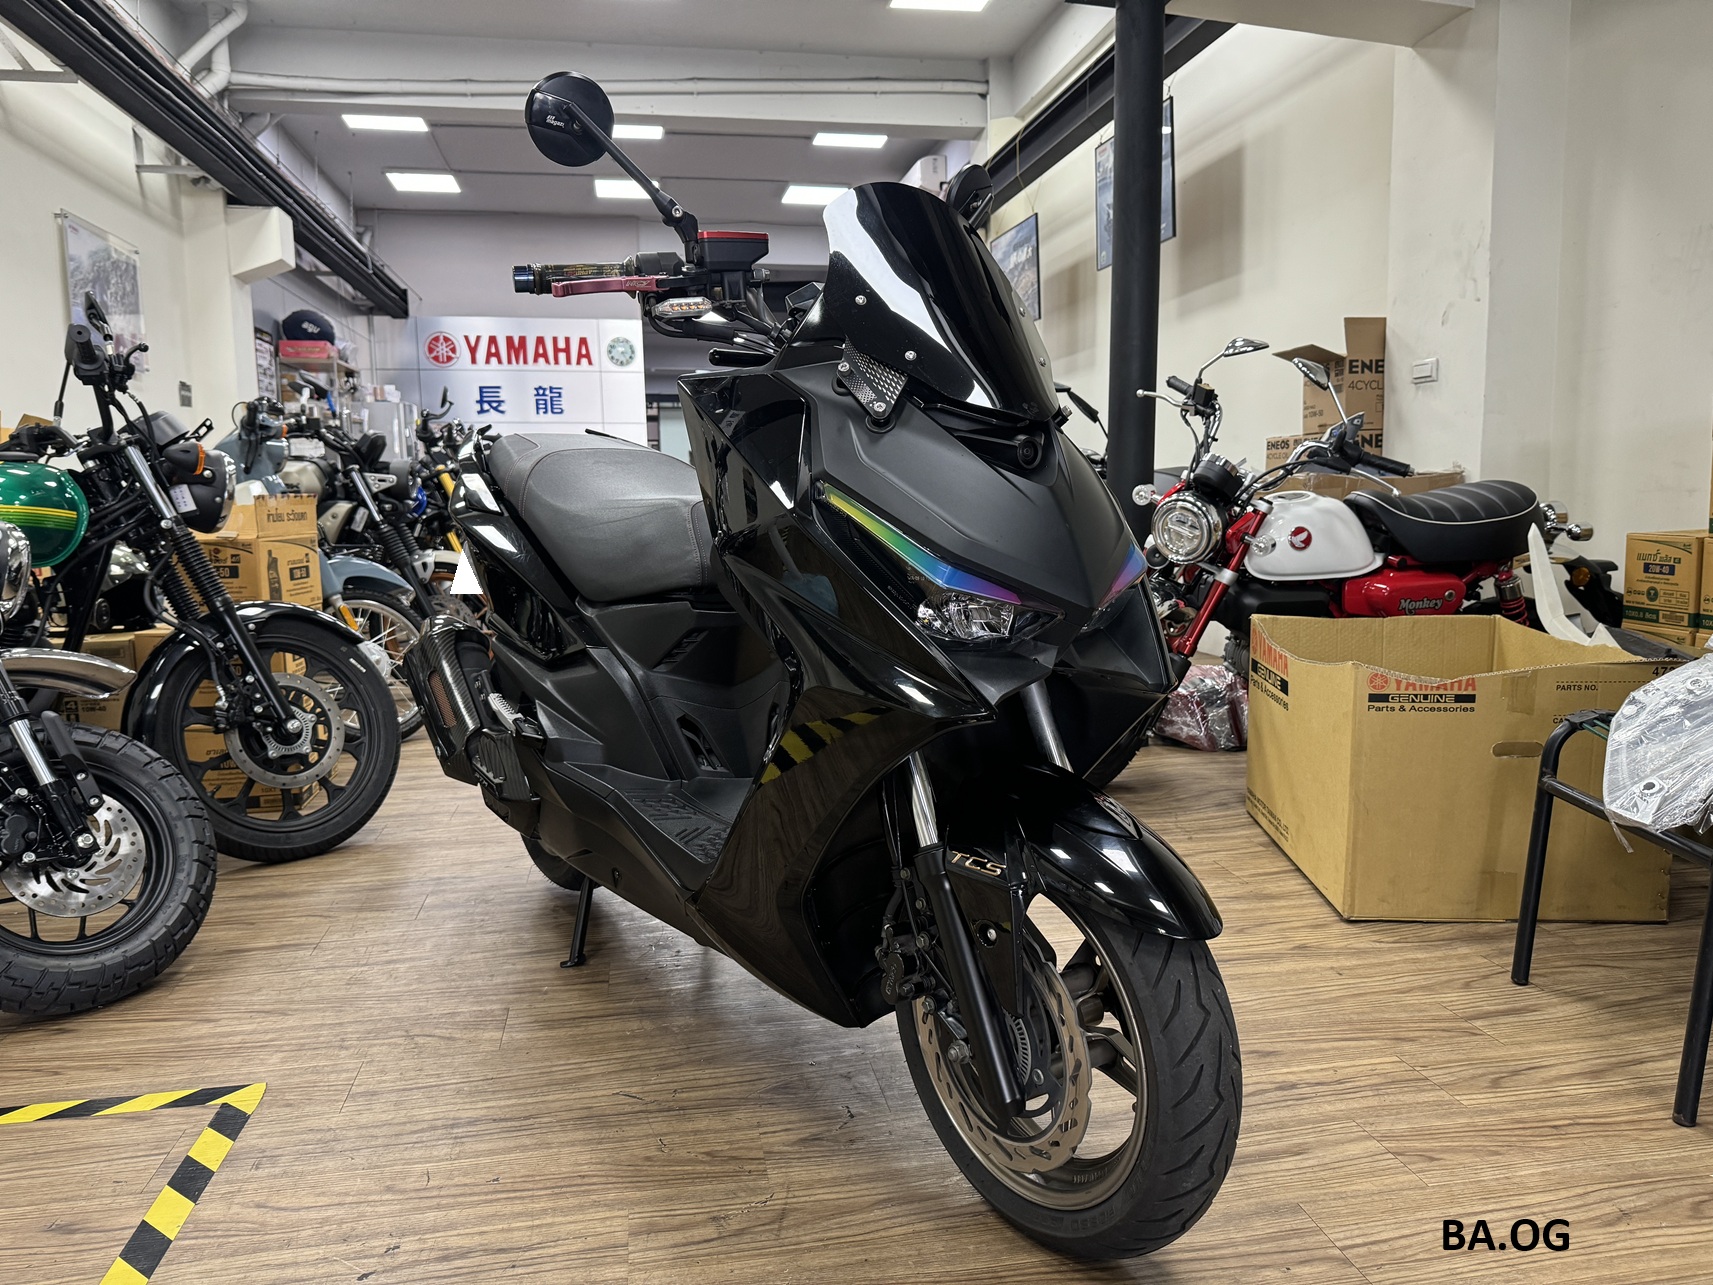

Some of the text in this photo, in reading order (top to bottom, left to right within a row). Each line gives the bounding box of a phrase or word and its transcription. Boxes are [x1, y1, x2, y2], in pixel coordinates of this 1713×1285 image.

[463, 335, 593, 366] YAMAHA
[475, 385, 564, 415] 長龍
[1266, 439, 1290, 451] ENEOS
[1399, 598, 1442, 614] Monkey
[1556, 684, 1599, 692] PARTS NO.
[1388, 694, 1456, 703] GENUINE
[1367, 704, 1476, 713] Parts & Accessories
[950, 850, 1007, 877] TCS
